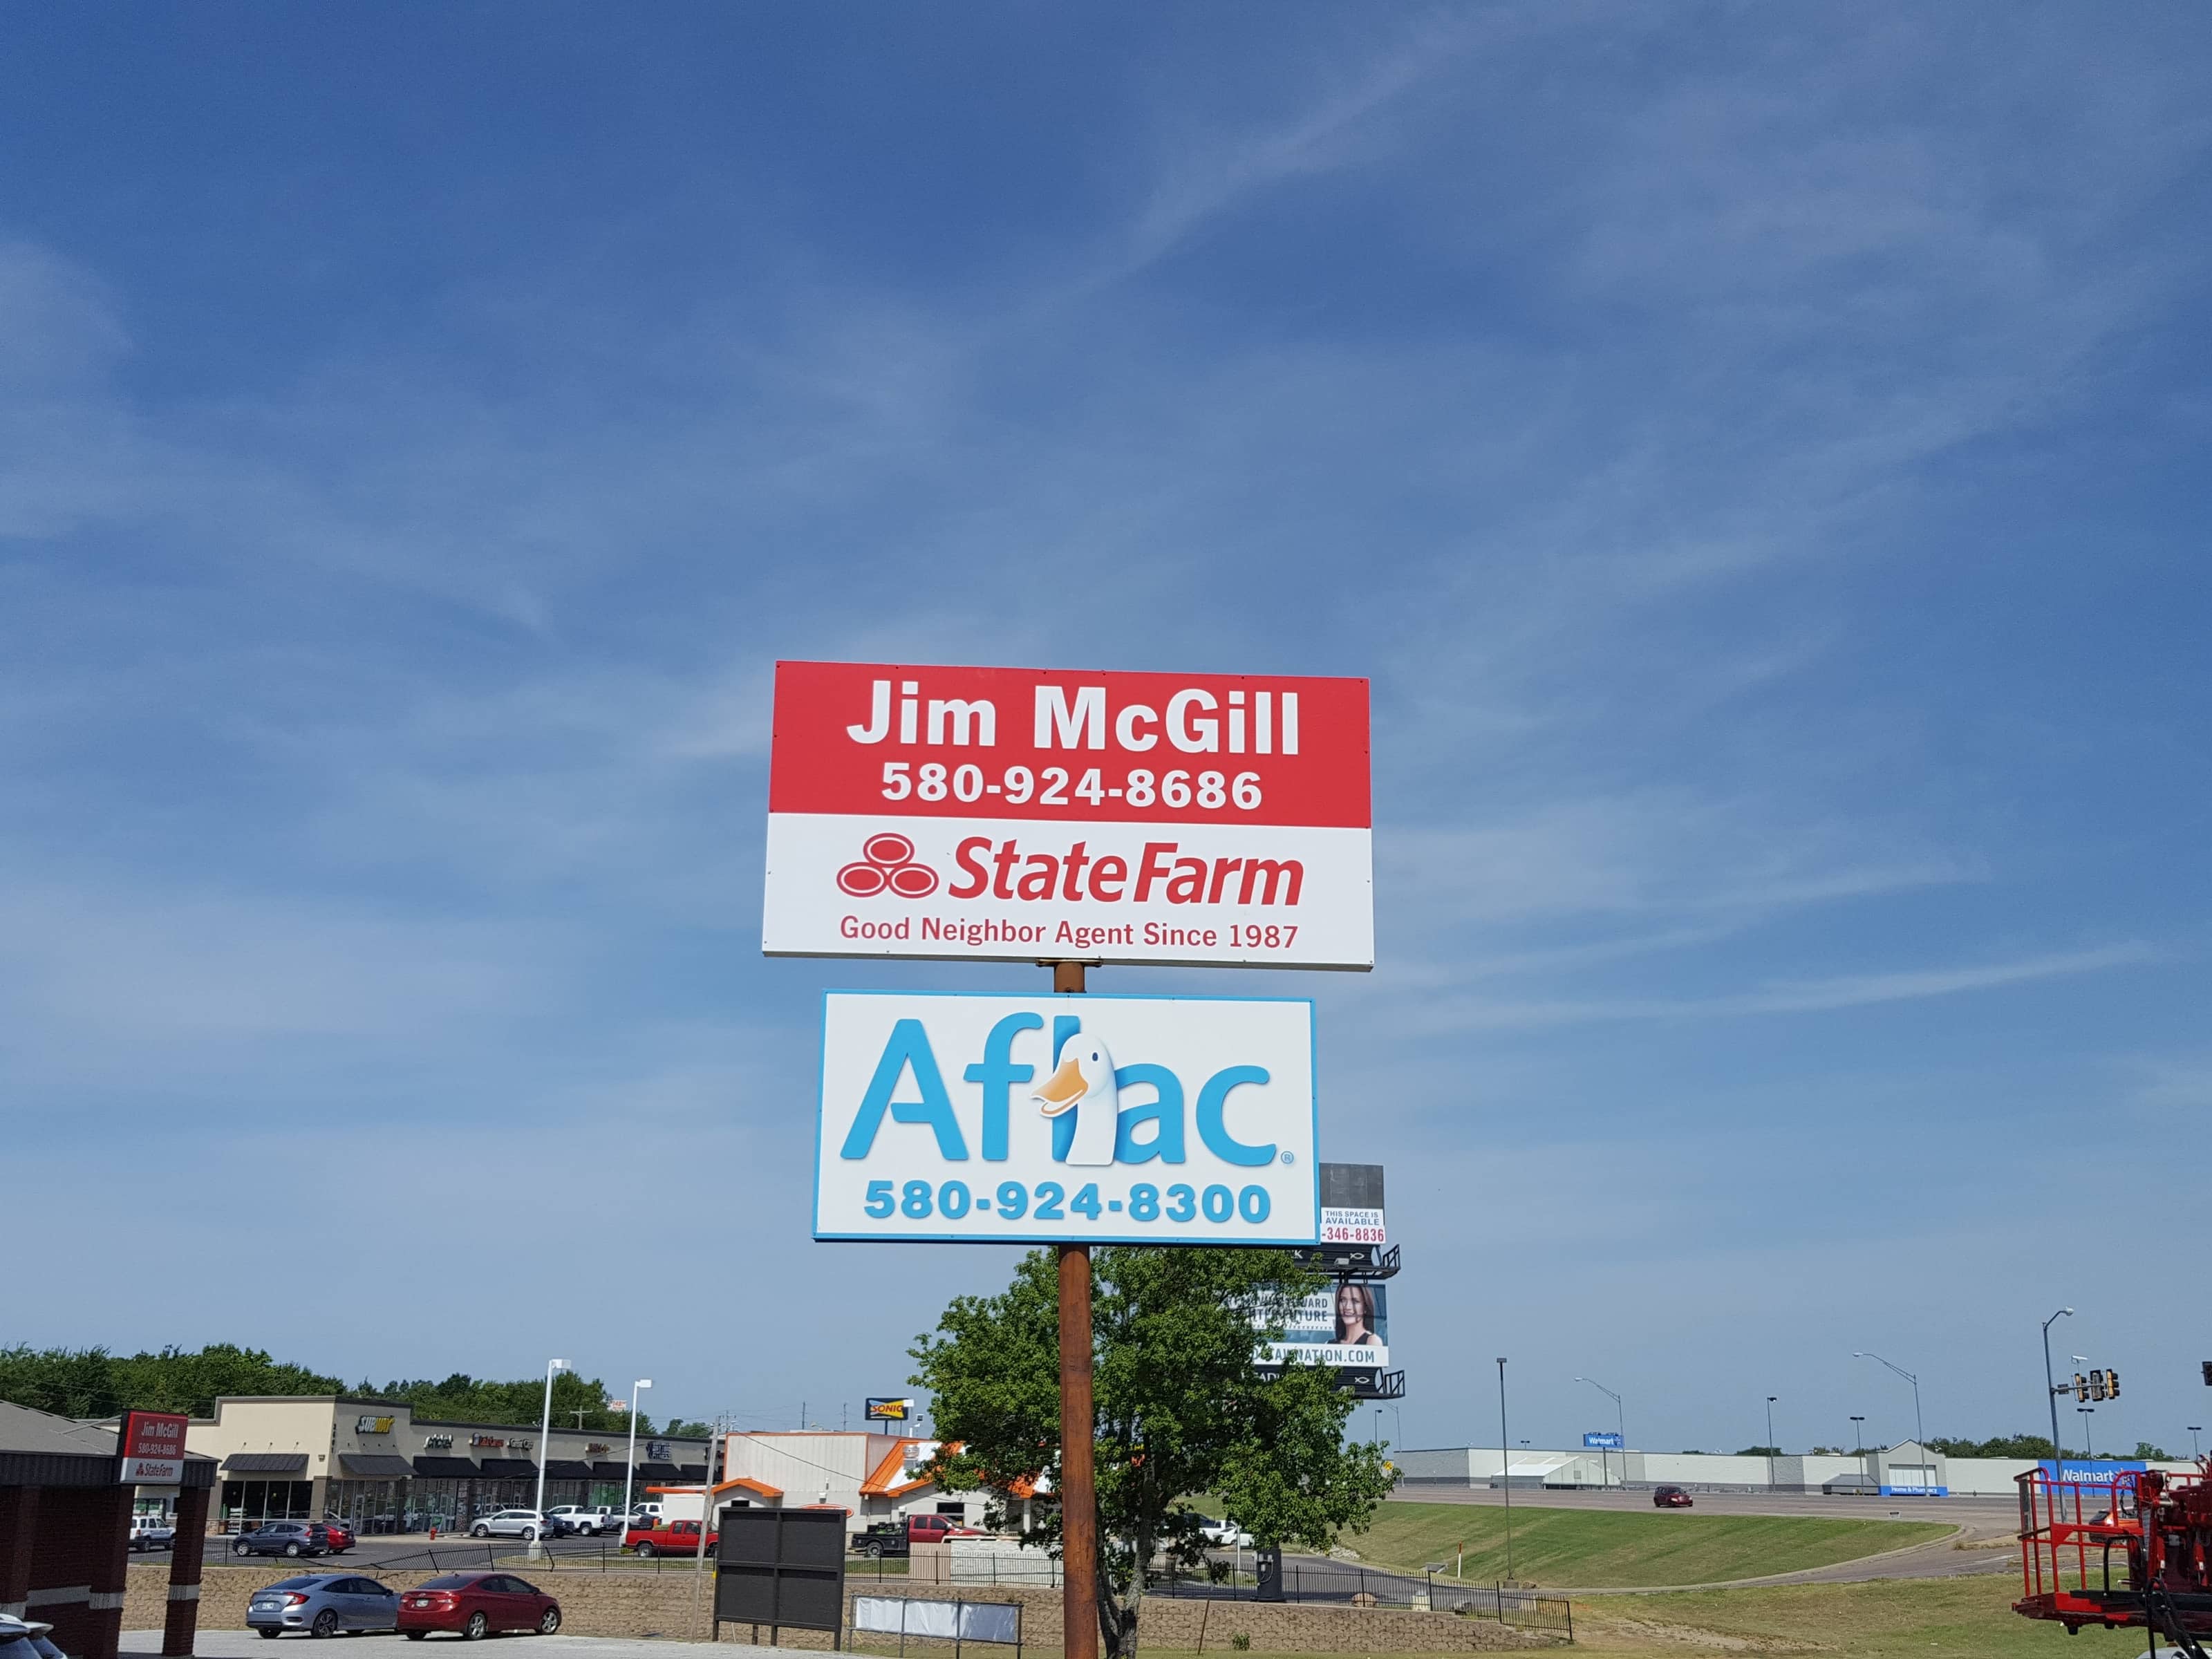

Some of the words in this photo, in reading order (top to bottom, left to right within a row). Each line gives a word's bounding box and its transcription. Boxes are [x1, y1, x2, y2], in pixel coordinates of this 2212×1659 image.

[847, 680, 996, 747] Jim
[1034, 685, 1299, 755] McGill
[881, 762, 1262, 810] 580-924-8686
[841, 915, 910, 939] Good
[921, 917, 1045, 946] Neighbor
[1056, 921, 1132, 948] Agent
[1144, 922, 1217, 946] Since
[1231, 924, 1298, 948] 1987
[840, 1011, 1277, 1168] Aflac
[863, 1179, 1271, 1224] 580-924-8300
[1325, 1217, 1380, 1226] AVAILABLE
[1321, 1227, 1385, 1242] -346-8836
[872, 1405, 903, 1413] SONIC
[141, 1421, 154, 1436] Jim
[156, 1423, 179, 1438] McGill
[358, 1416, 395, 1433] SUBWAY
[1588, 1436, 1615, 1445] Walmart
[2061, 1468, 2115, 1483] Walmart
